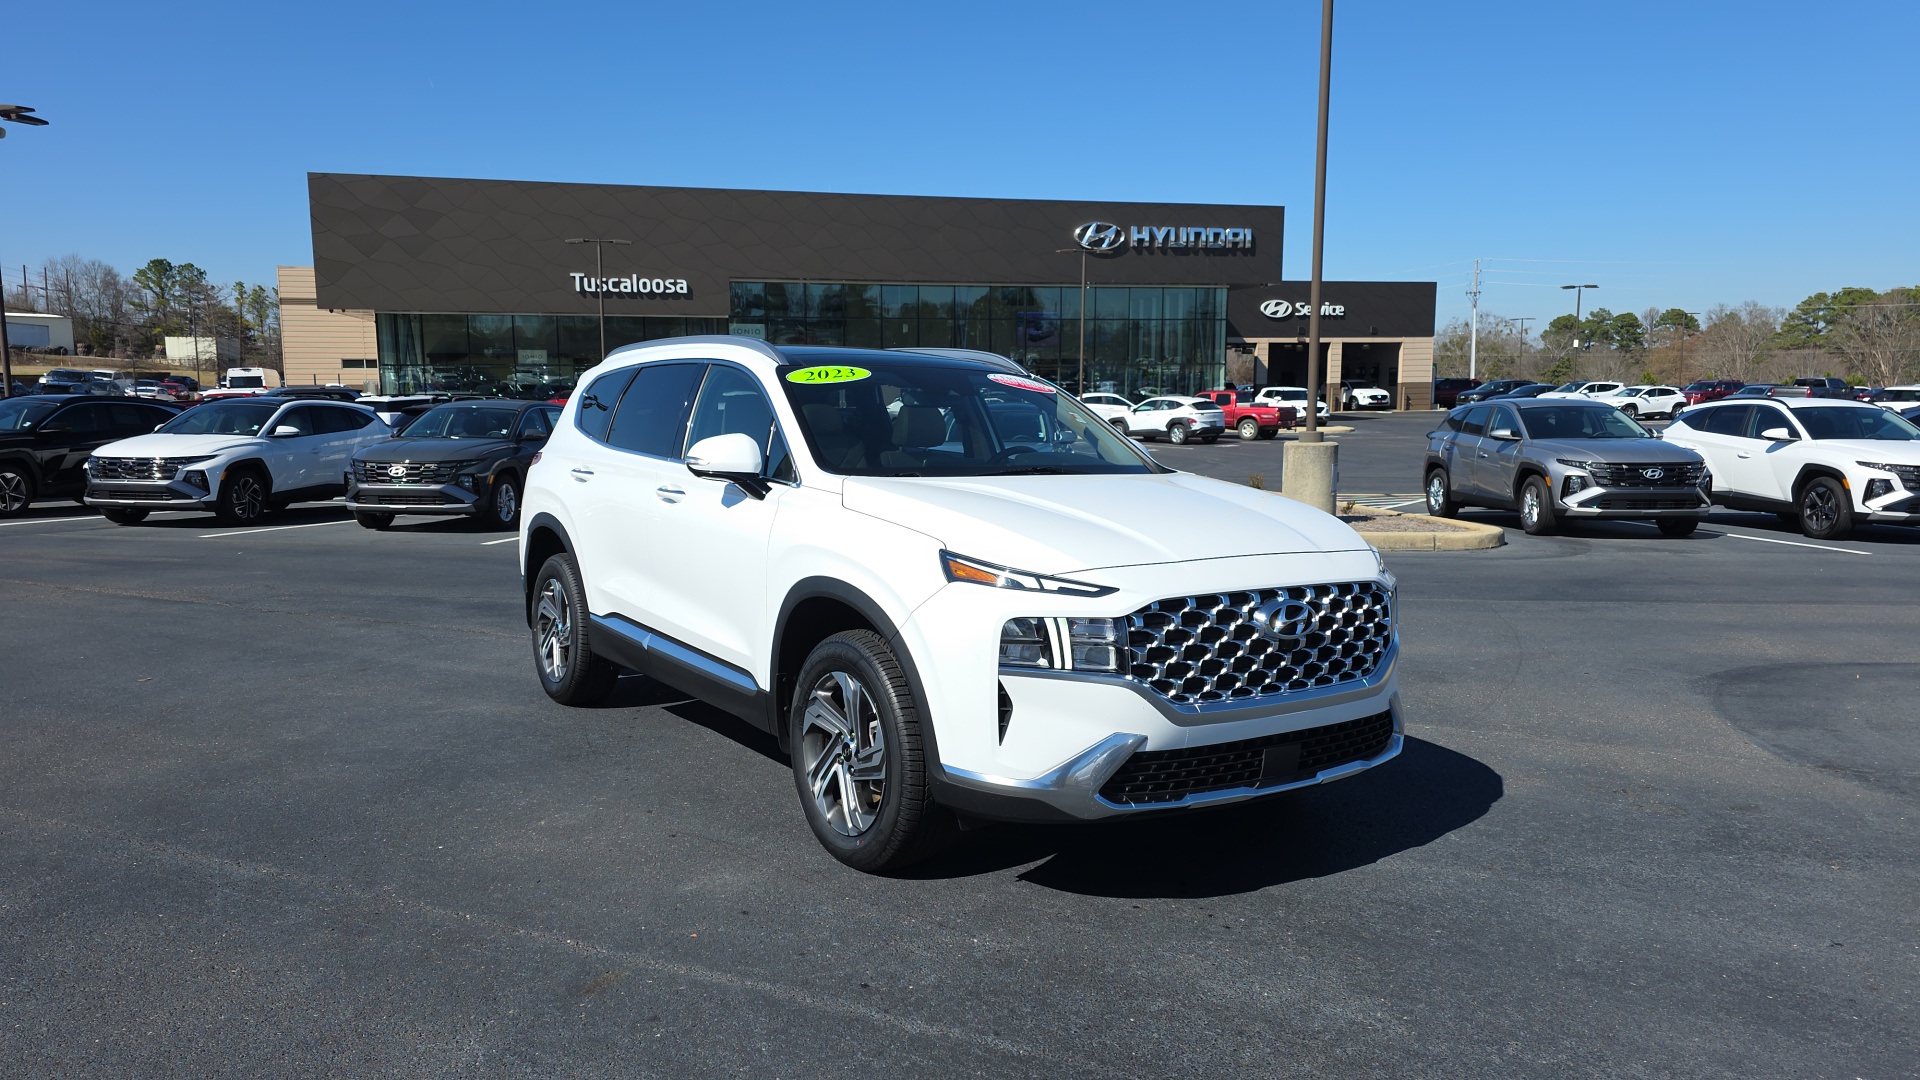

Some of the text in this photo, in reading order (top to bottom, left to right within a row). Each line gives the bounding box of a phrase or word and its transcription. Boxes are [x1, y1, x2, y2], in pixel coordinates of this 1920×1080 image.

[1130, 226, 1252, 249] HYUNDAI
[569, 272, 688, 294] Tuscaloosa
[1295, 301, 1345, 316] Sevice
[803, 368, 856, 382] 2023
